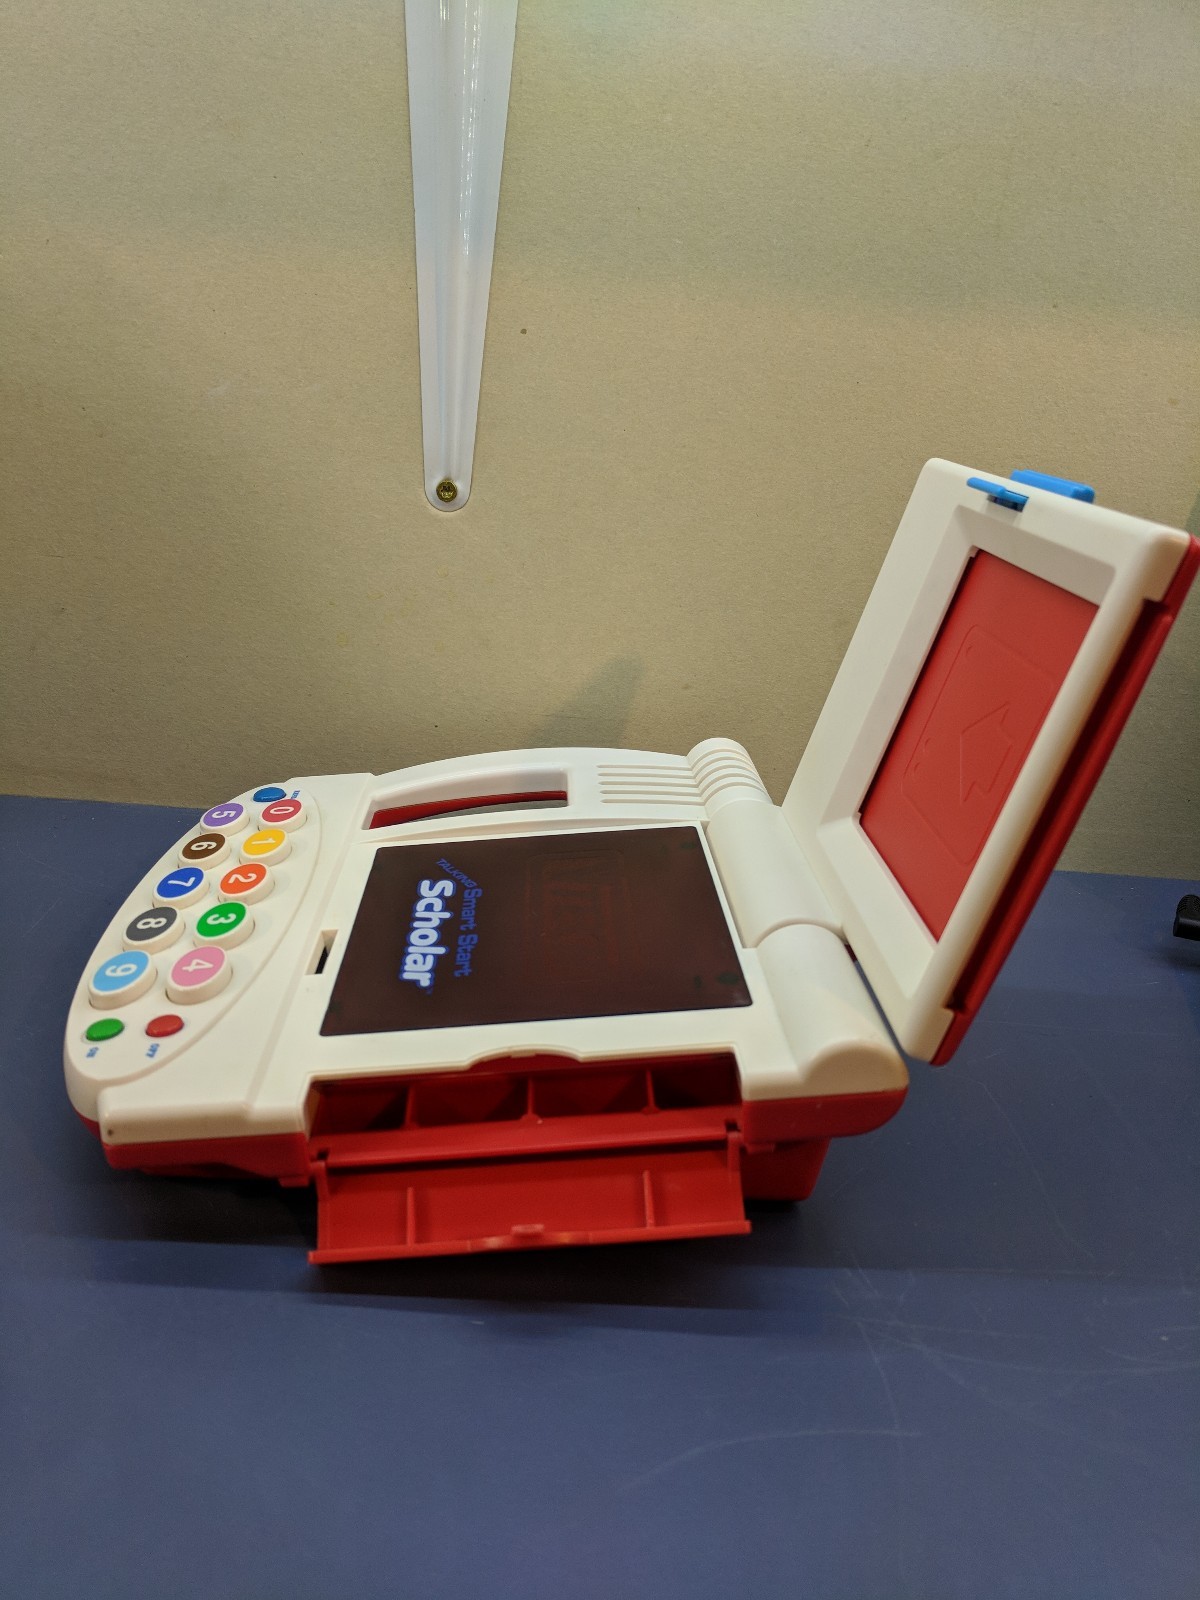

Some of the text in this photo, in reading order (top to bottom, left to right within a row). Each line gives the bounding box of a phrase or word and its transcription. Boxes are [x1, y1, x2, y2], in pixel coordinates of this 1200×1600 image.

[211, 810, 237, 819] 5
[269, 806, 294, 815] 0
[190, 841, 217, 851] 6
[251, 837, 276, 845] 1
[167, 876, 196, 887] 7
[228, 873, 257, 884] 2
[136, 917, 167, 930] 8
[206, 913, 237, 925] 3
[401, 879, 455, 988] Scholar
[453, 888, 482, 977] Smart Start
[105, 963, 138, 977] 9
[182, 958, 214, 973] 4
